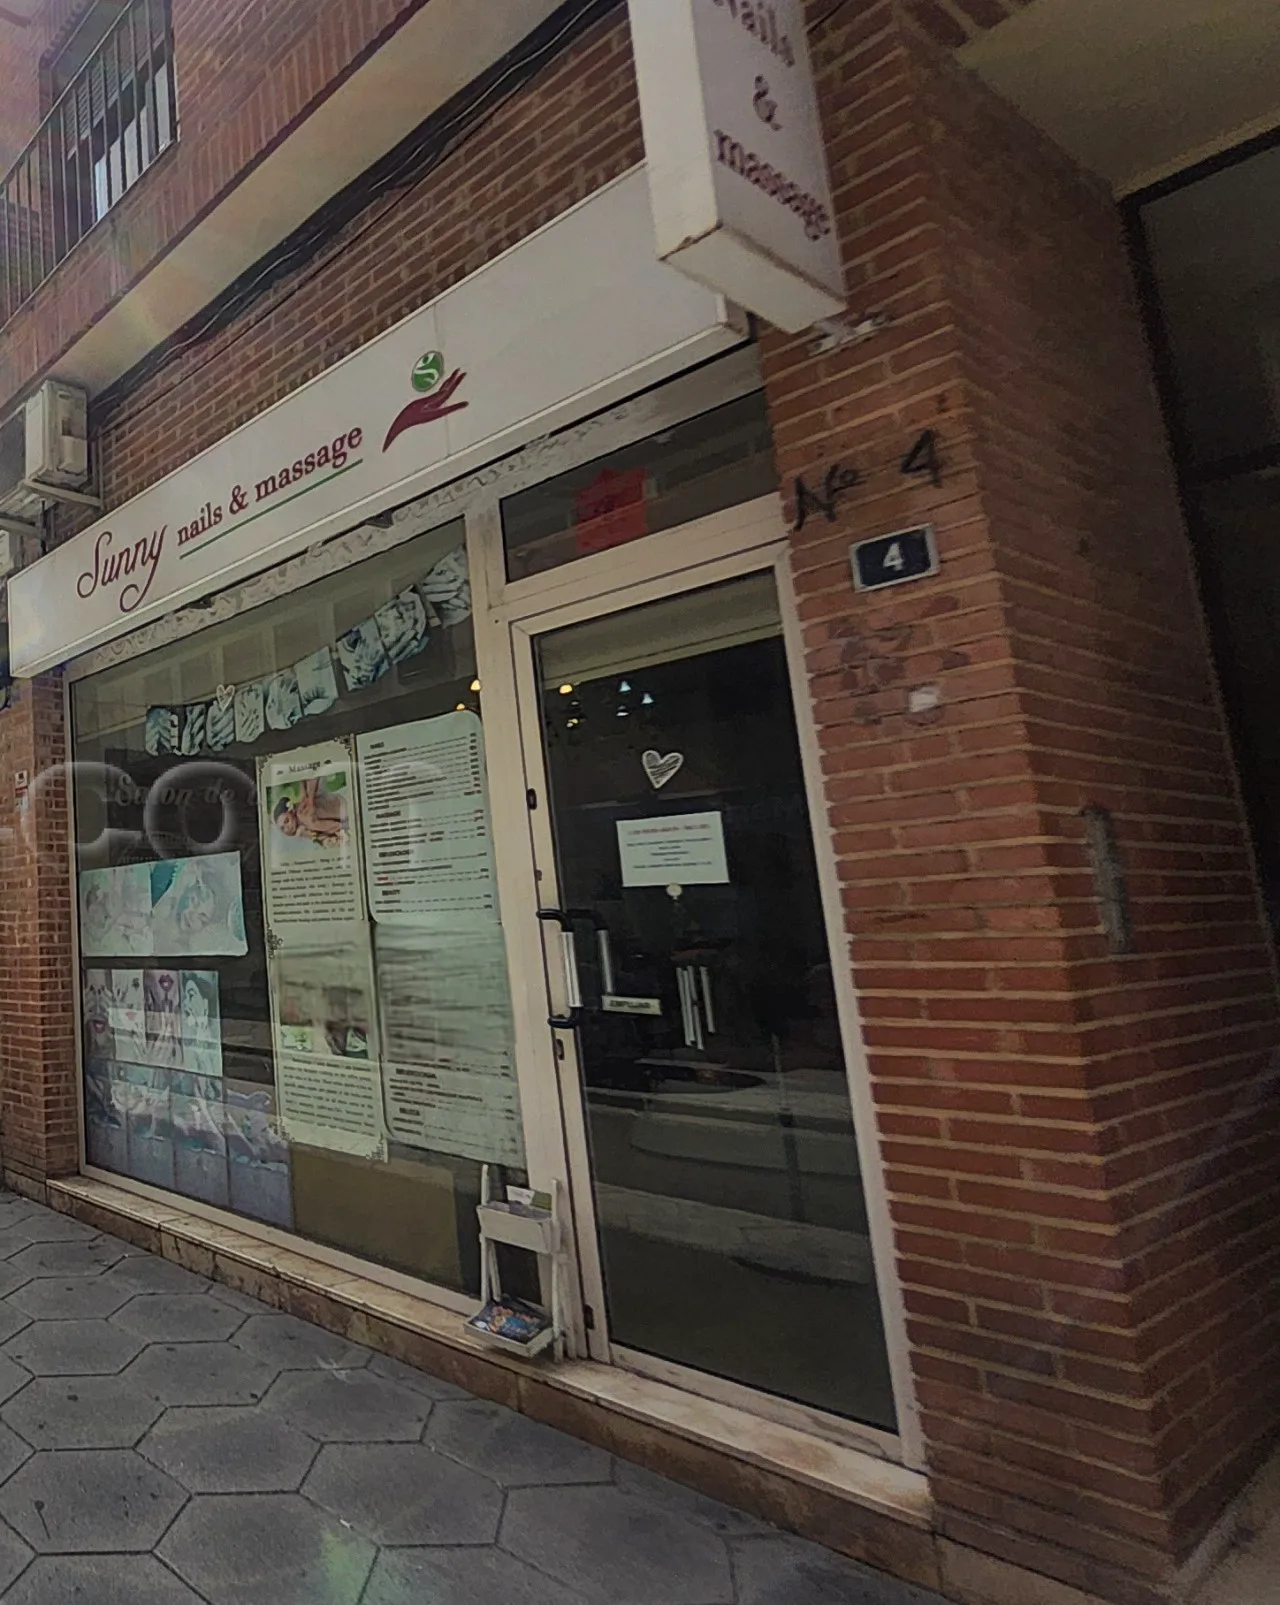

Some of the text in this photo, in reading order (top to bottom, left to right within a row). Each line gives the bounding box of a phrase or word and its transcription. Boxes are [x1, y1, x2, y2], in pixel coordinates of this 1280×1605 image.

[752, 75, 782, 131] &
[713, 129, 830, 242] massage
[900, 428, 944, 489] 4
[76, 425, 365, 613] Sunny nails & massage
[882, 541, 905, 572] 4
[114, 774, 194, 806] Saon
